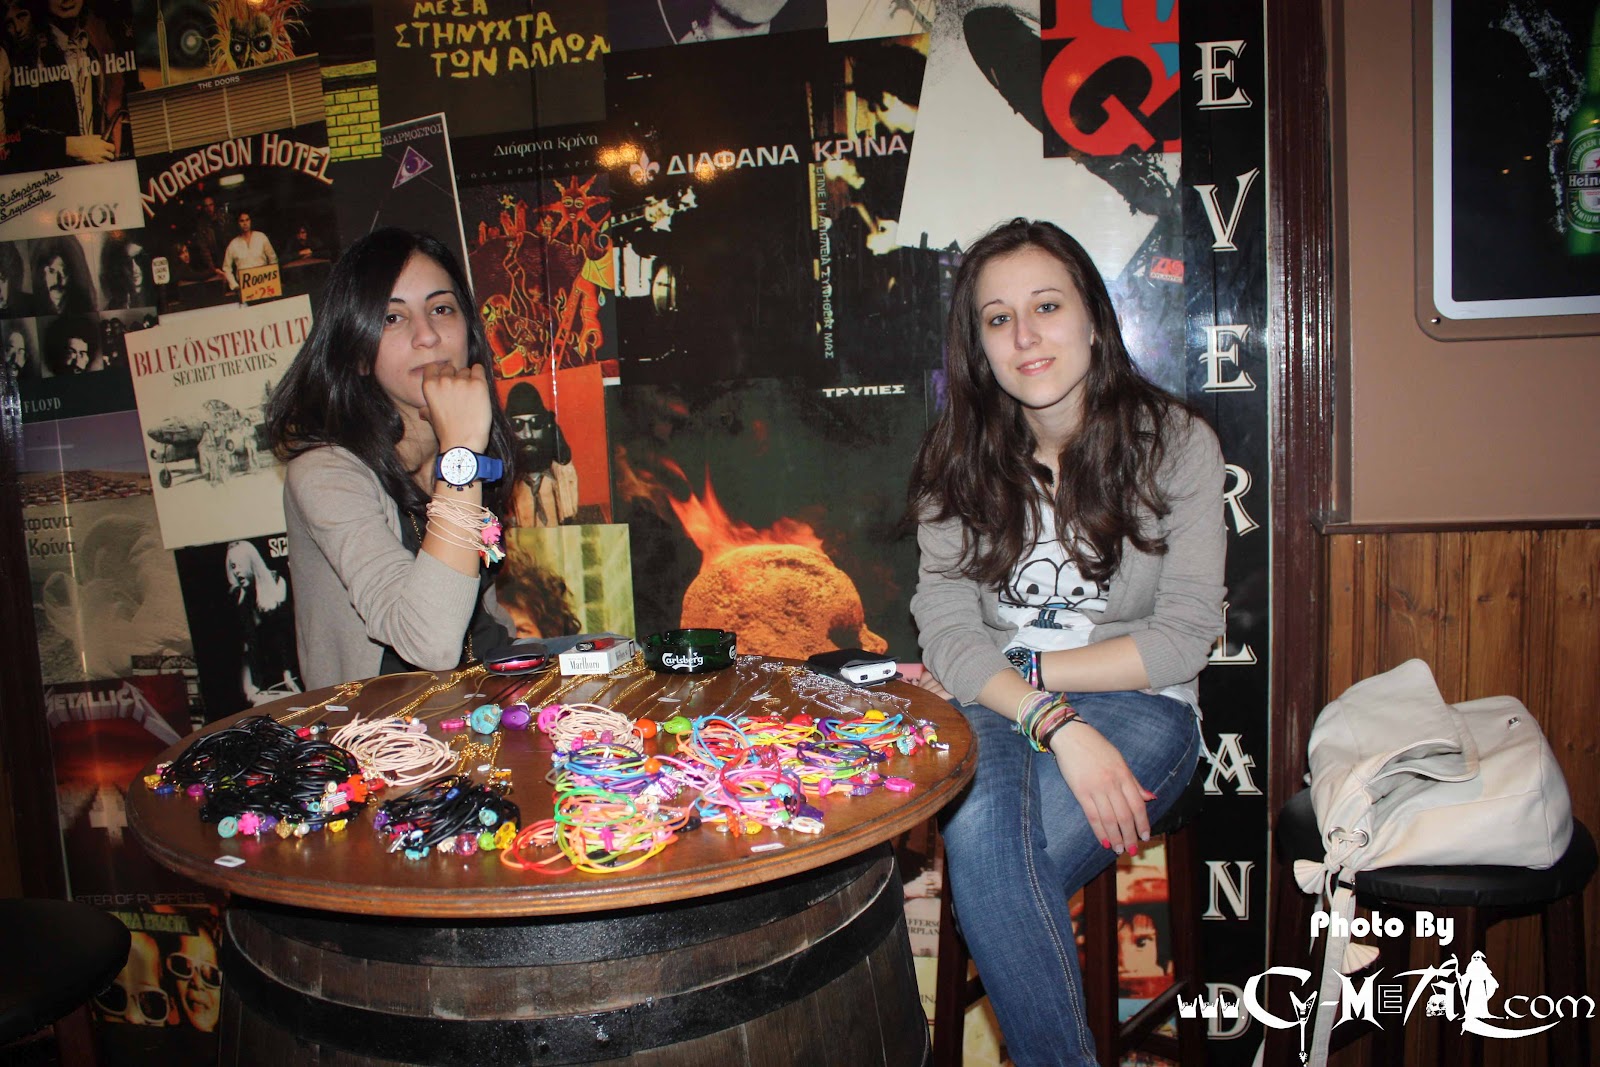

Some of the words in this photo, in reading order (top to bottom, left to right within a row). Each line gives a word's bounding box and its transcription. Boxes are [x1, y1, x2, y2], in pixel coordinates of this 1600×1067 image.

[104, 50, 137, 75] Hell
[197, 81, 213, 90] THE
[213, 75, 240, 87] DOORS
[381, 123, 444, 148] ΣΑΡΜΟΣΤΟΙ
[666, 143, 800, 177] ΔΙΑΦΑΝΑ
[813, 134, 909, 163] ΚΡΙΝΑ
[140, 137, 252, 218] MORRISON
[262, 133, 335, 185] HOTEL
[1568, 174, 1600, 188] Hein
[133, 344, 181, 378] BLUE
[183, 328, 257, 368] ÖYSTER
[259, 316, 310, 348] CULT
[173, 364, 217, 387] SECRET
[220, 353, 278, 377] TREATIES
[822, 384, 906, 398] ΤΡΥΠΕΣ
[23, 396, 62, 413] FLOYD
[25, 515, 74, 535] φανα
[661, 652, 704, 670] Carlsberg
[74, 893, 114, 907] STER
